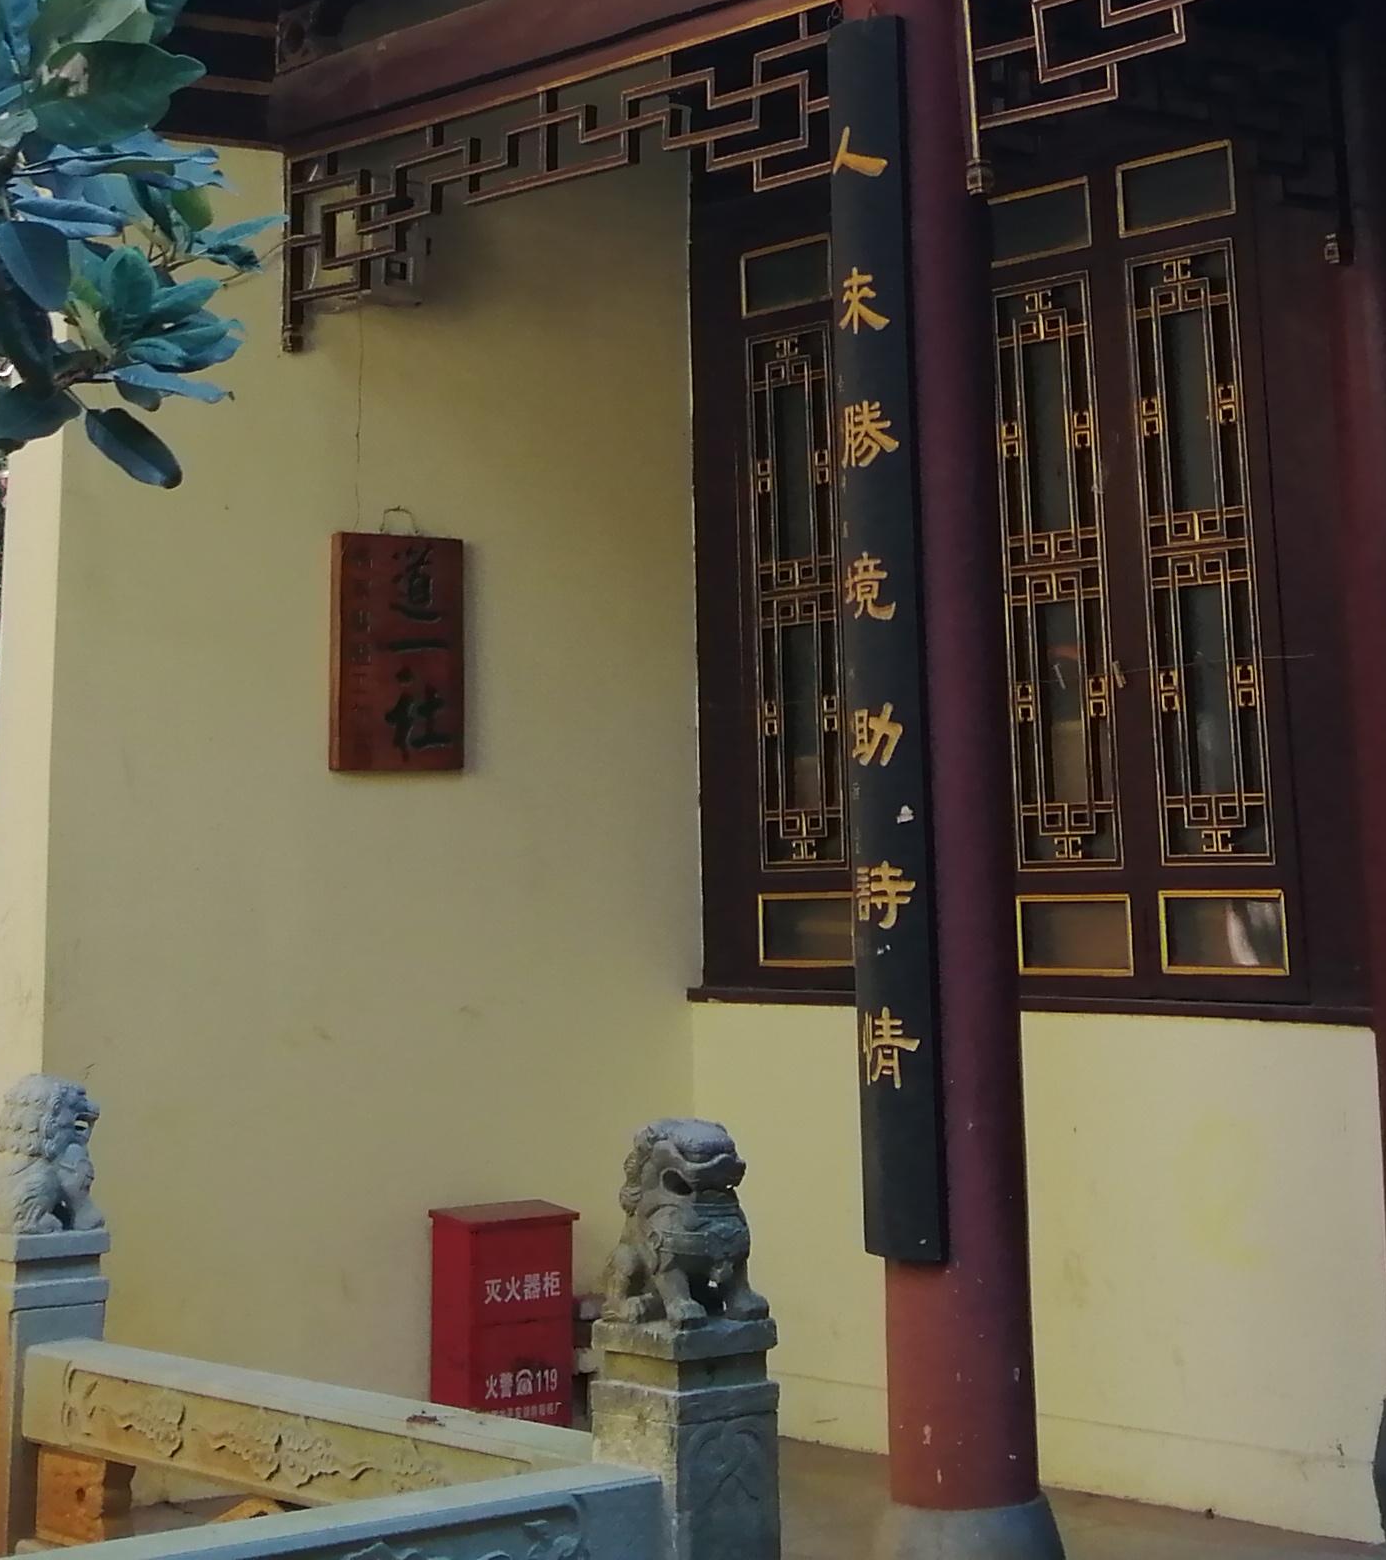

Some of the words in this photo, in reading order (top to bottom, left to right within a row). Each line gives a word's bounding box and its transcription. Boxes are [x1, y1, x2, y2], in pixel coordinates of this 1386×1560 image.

[832, 125, 920, 1090] 人來勝境助詩情
[484, 1271, 561, 1304] 灭火器柜
[485, 1372, 513, 1400] 火警
[536, 1368, 558, 1393] 119
